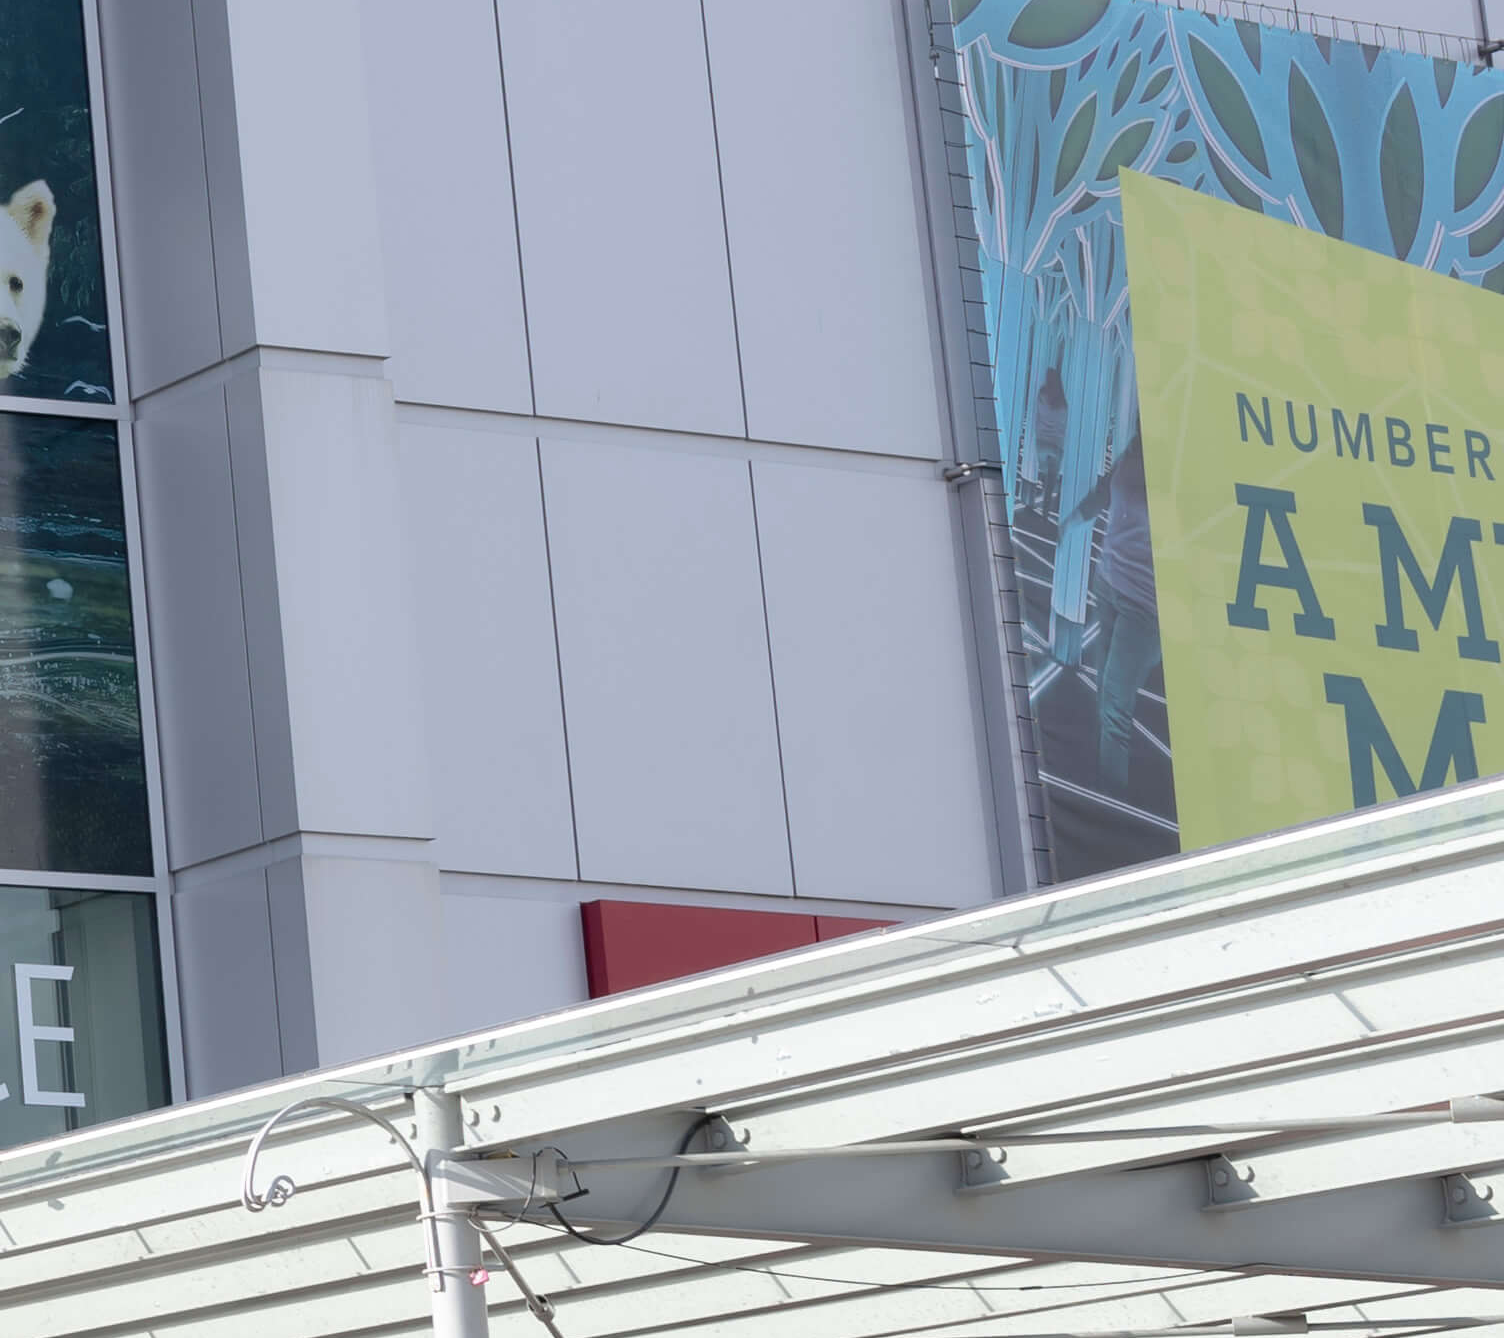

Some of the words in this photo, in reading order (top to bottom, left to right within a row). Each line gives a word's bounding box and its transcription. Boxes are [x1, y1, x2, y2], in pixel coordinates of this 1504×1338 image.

[1236, 392, 1495, 481] NUMBER
[1226, 482, 1336, 641] A
[1362, 501, 1504, 663] M
